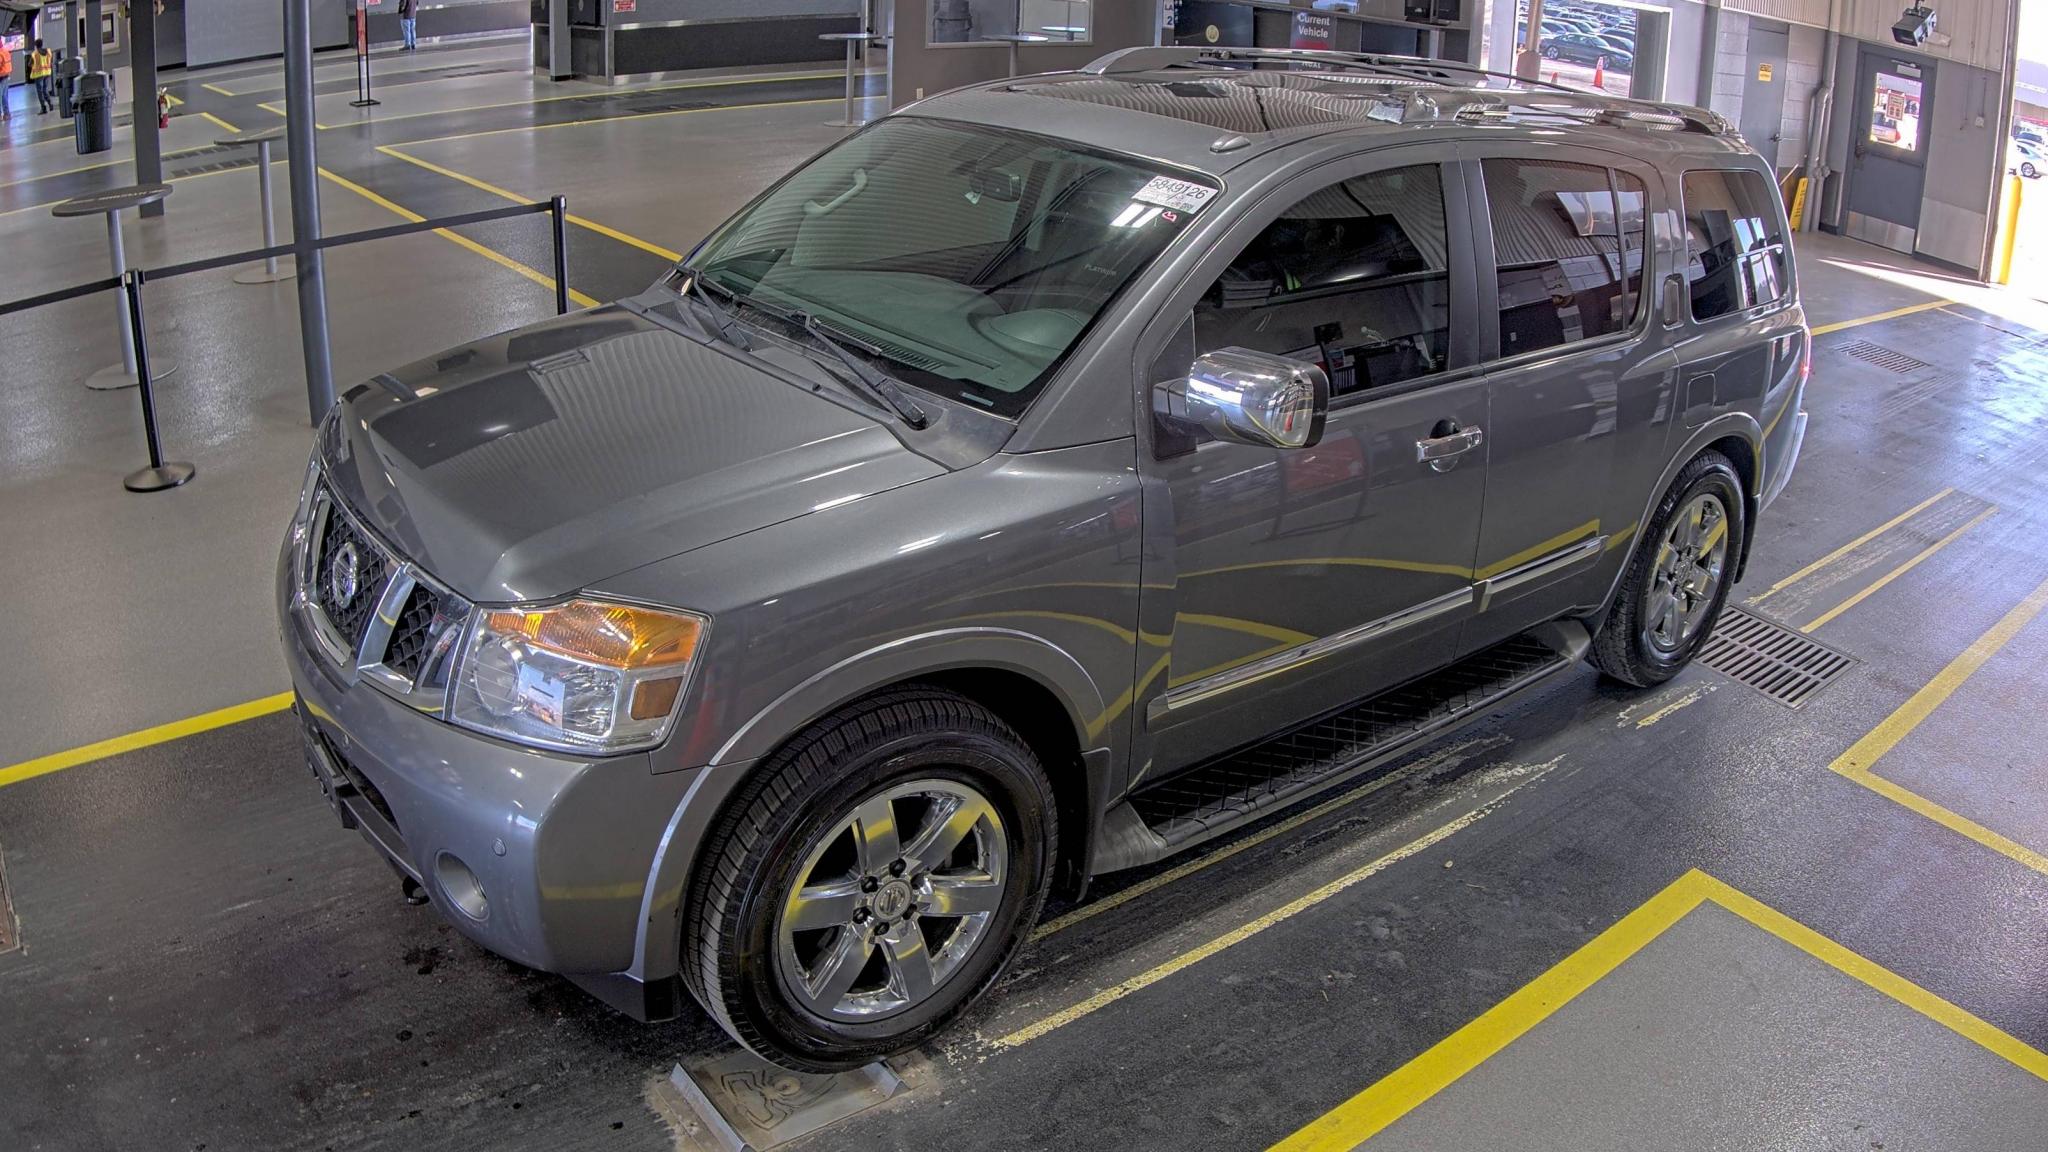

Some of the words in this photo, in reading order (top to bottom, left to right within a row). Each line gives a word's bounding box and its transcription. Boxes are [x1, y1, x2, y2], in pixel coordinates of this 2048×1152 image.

[1297, 12, 1331, 26] Current
[1298, 25, 1329, 39] Vehicle
[1148, 179, 1209, 199] 5849126
